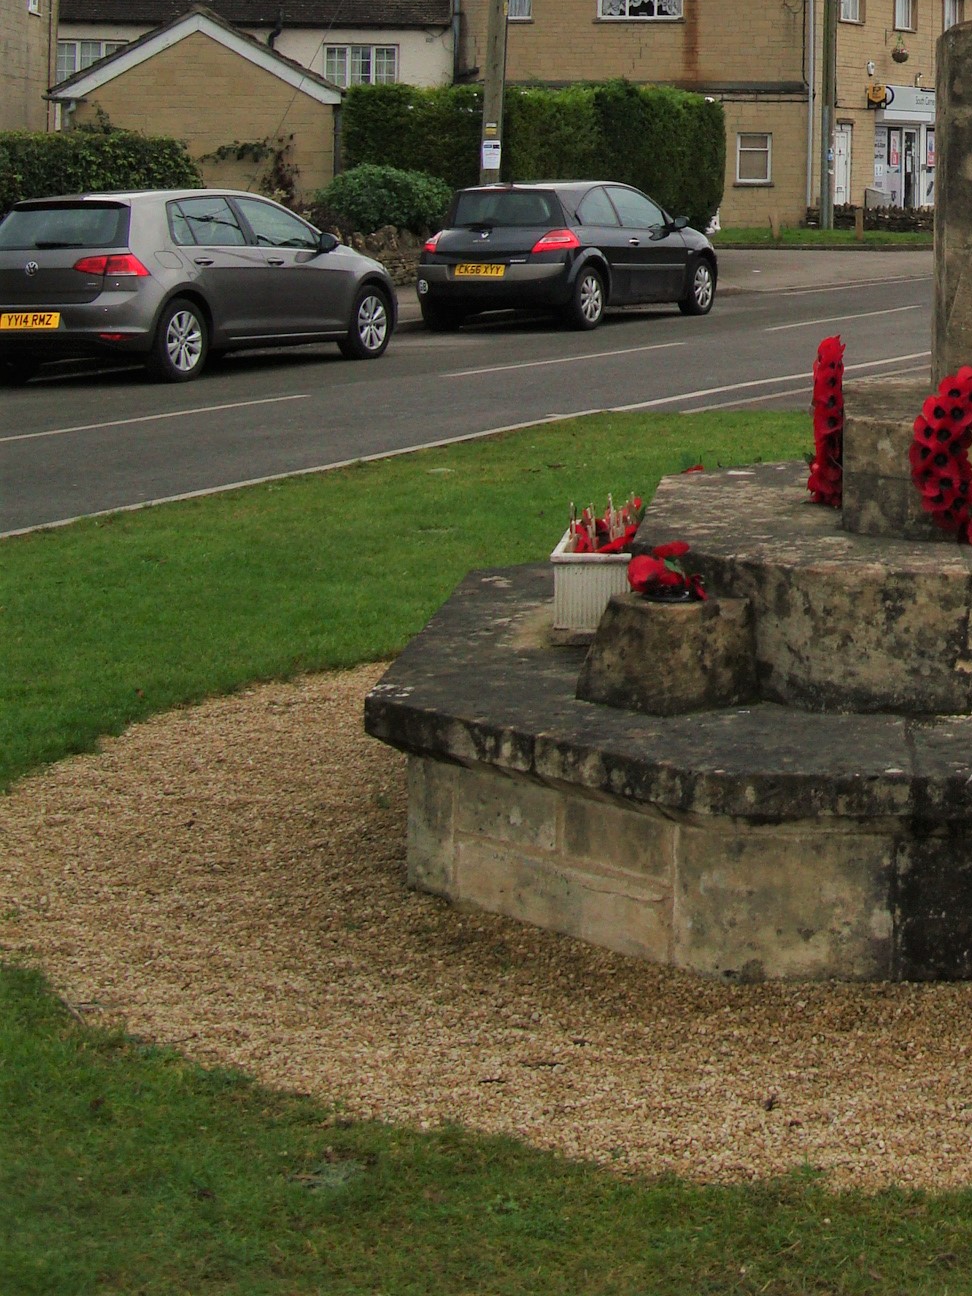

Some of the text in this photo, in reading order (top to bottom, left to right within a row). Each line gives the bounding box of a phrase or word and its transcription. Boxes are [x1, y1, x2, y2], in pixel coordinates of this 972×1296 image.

[458, 265, 502, 275] CK56 XYY
[7, 314, 53, 326] YY14 RMZ
